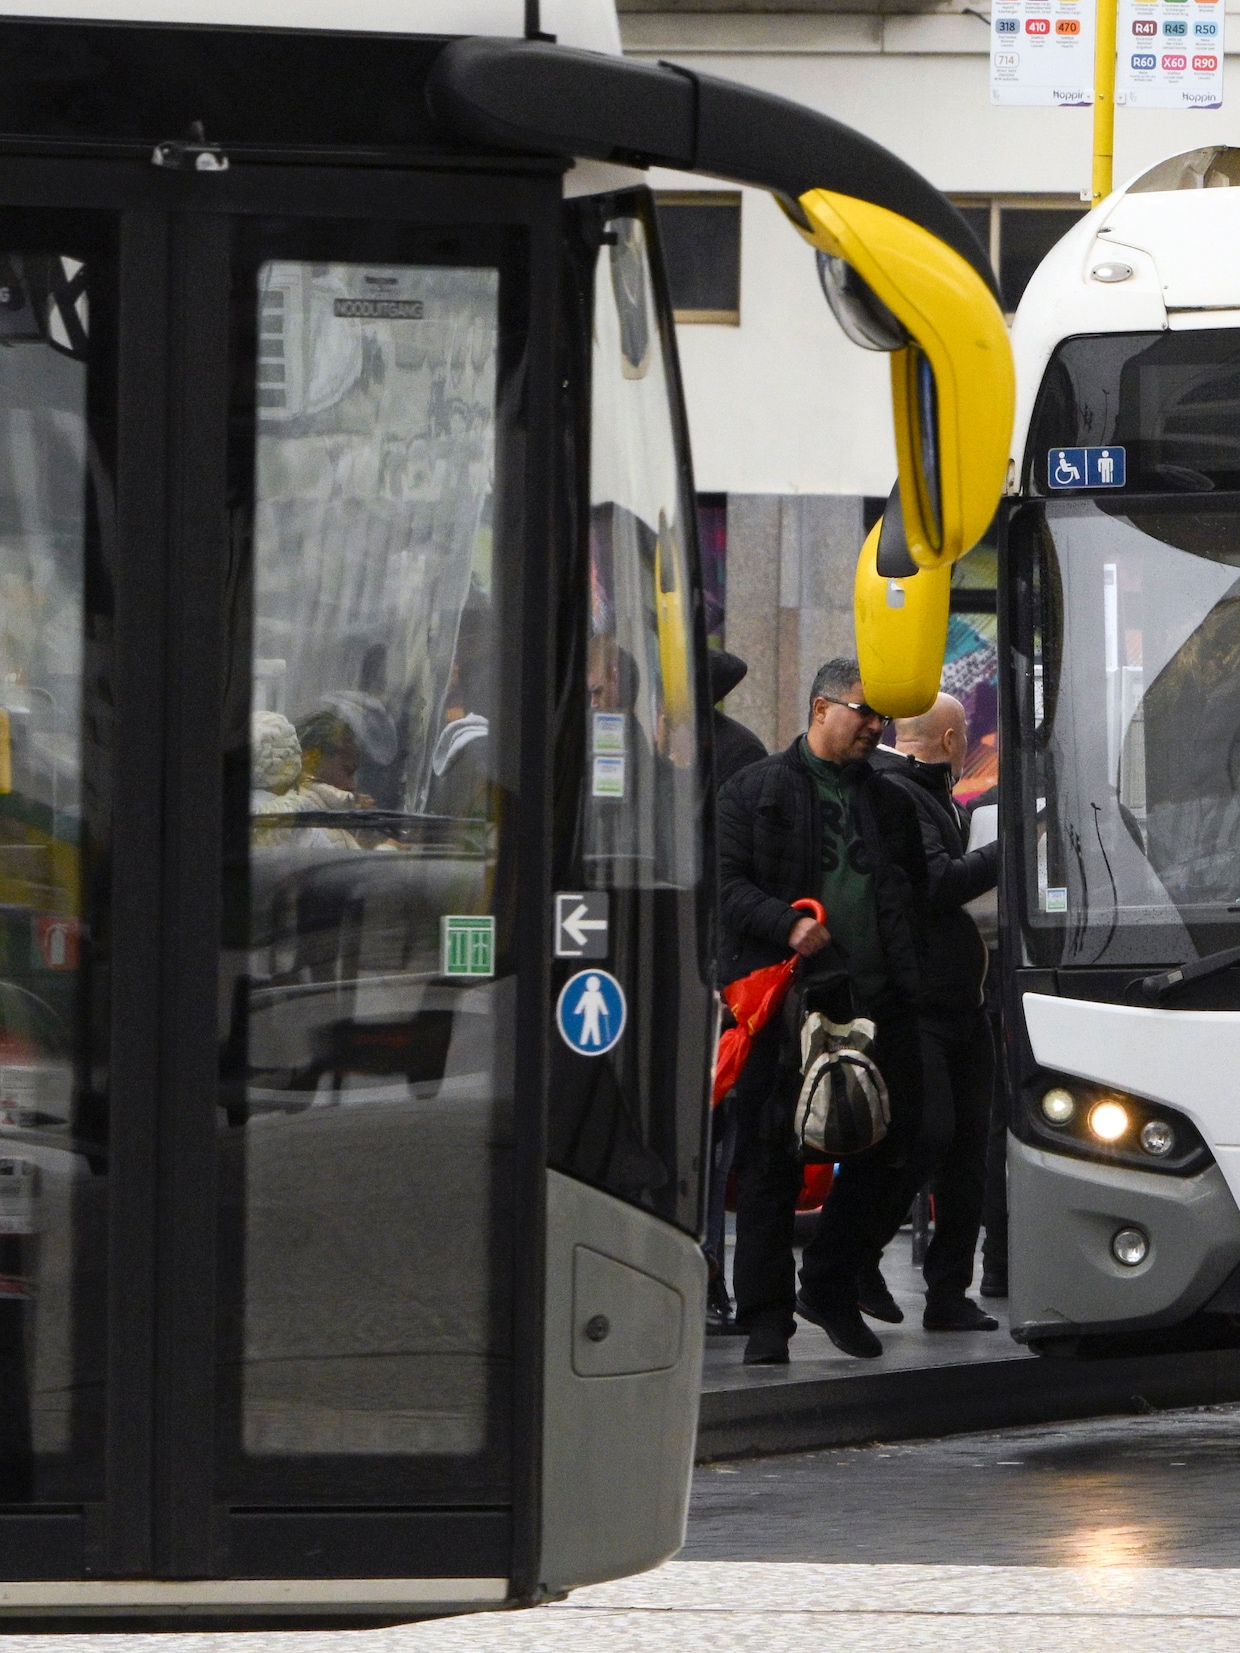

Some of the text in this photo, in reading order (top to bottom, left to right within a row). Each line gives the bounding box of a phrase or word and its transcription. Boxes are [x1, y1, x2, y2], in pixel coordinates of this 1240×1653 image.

[999, 22, 1016, 32] 318
[1028, 22, 1047, 32] 410
[1058, 22, 1077, 32] 470
[1135, 23, 1154, 34] R41
[1165, 24, 1185, 34] R45
[1195, 24, 1216, 35] R50
[998, 55, 1014, 65] 714
[1132, 57, 1154, 67] R60
[1163, 58, 1185, 68] X60
[1194, 58, 1215, 69] R90
[1182, 91, 1216, 103] Hoppin
